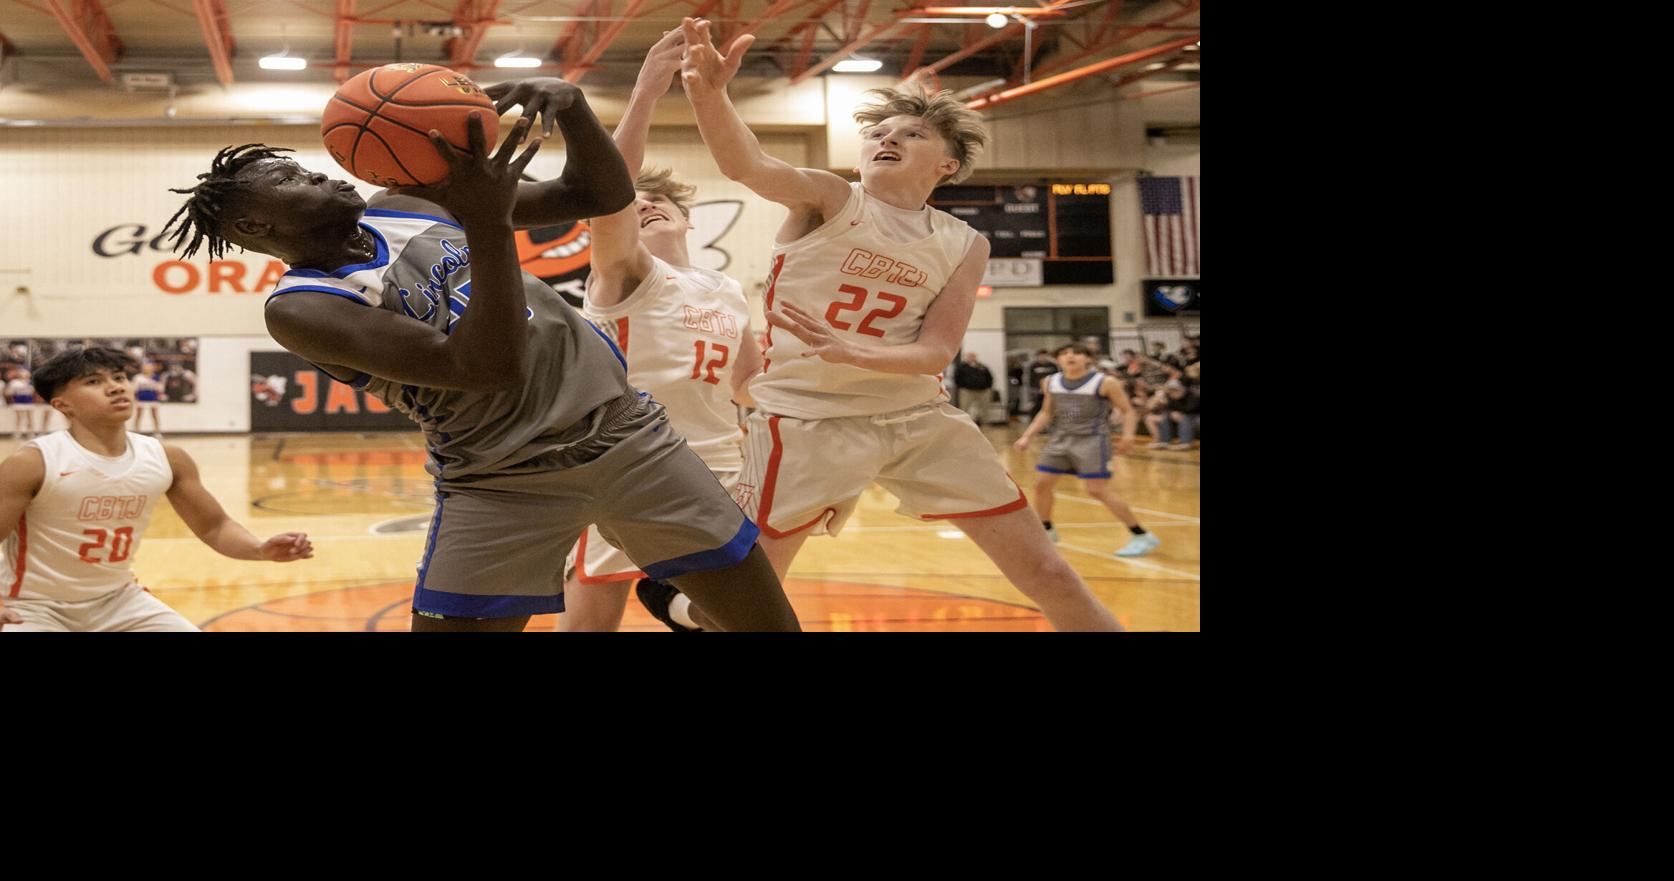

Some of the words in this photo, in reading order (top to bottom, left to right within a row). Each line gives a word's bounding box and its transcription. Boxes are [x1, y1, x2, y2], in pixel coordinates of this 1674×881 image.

[399, 239, 471, 321] Lincol
[841, 247, 928, 287] CBTJ
[683, 305, 738, 339] CBTJ
[825, 283, 908, 338] 22
[690, 340, 729, 385] 12
[77, 495, 147, 521] CBTJ
[79, 526, 134, 564] 20
